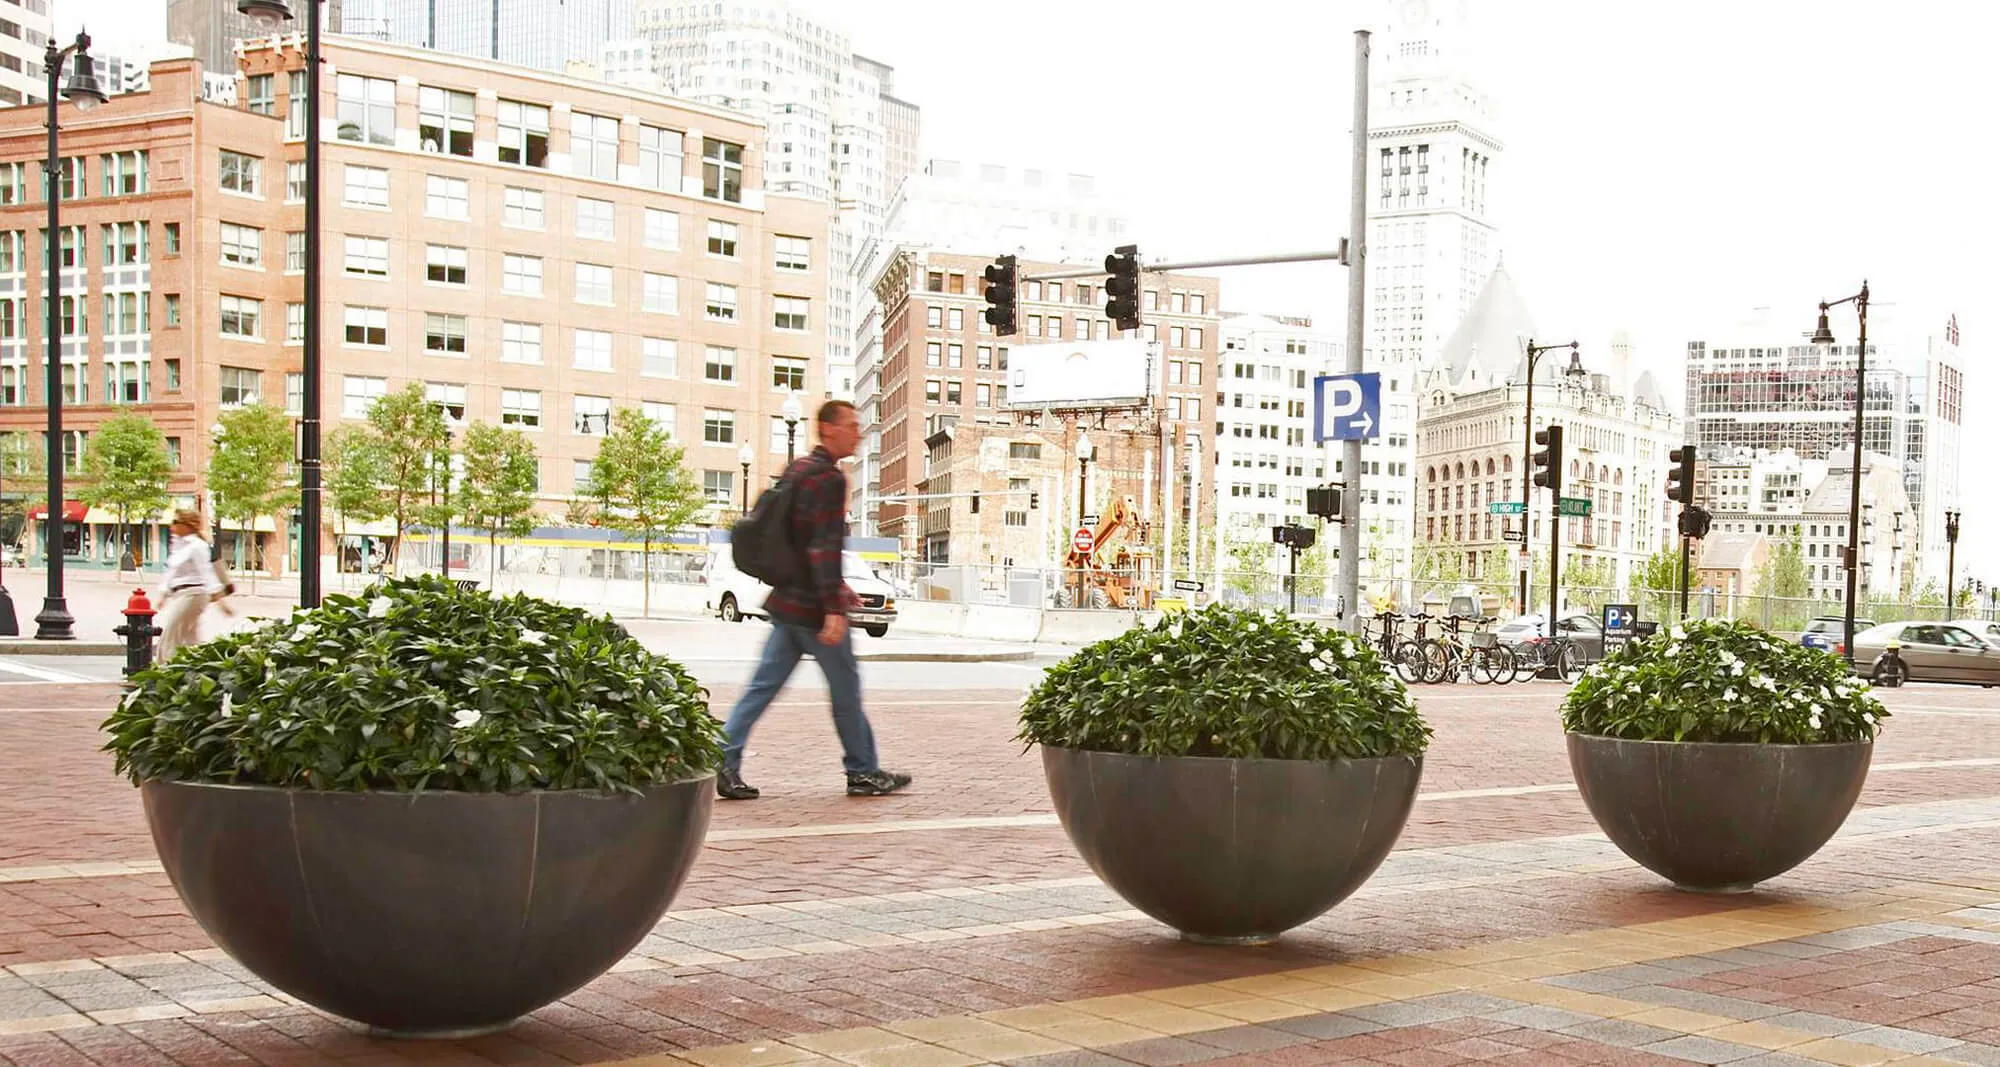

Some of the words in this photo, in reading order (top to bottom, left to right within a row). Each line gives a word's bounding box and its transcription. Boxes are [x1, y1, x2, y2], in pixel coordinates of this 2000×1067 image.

[1322, 379, 1363, 438] P
[1608, 609, 1619, 626] P
[1604, 636, 1626, 644] Parking
